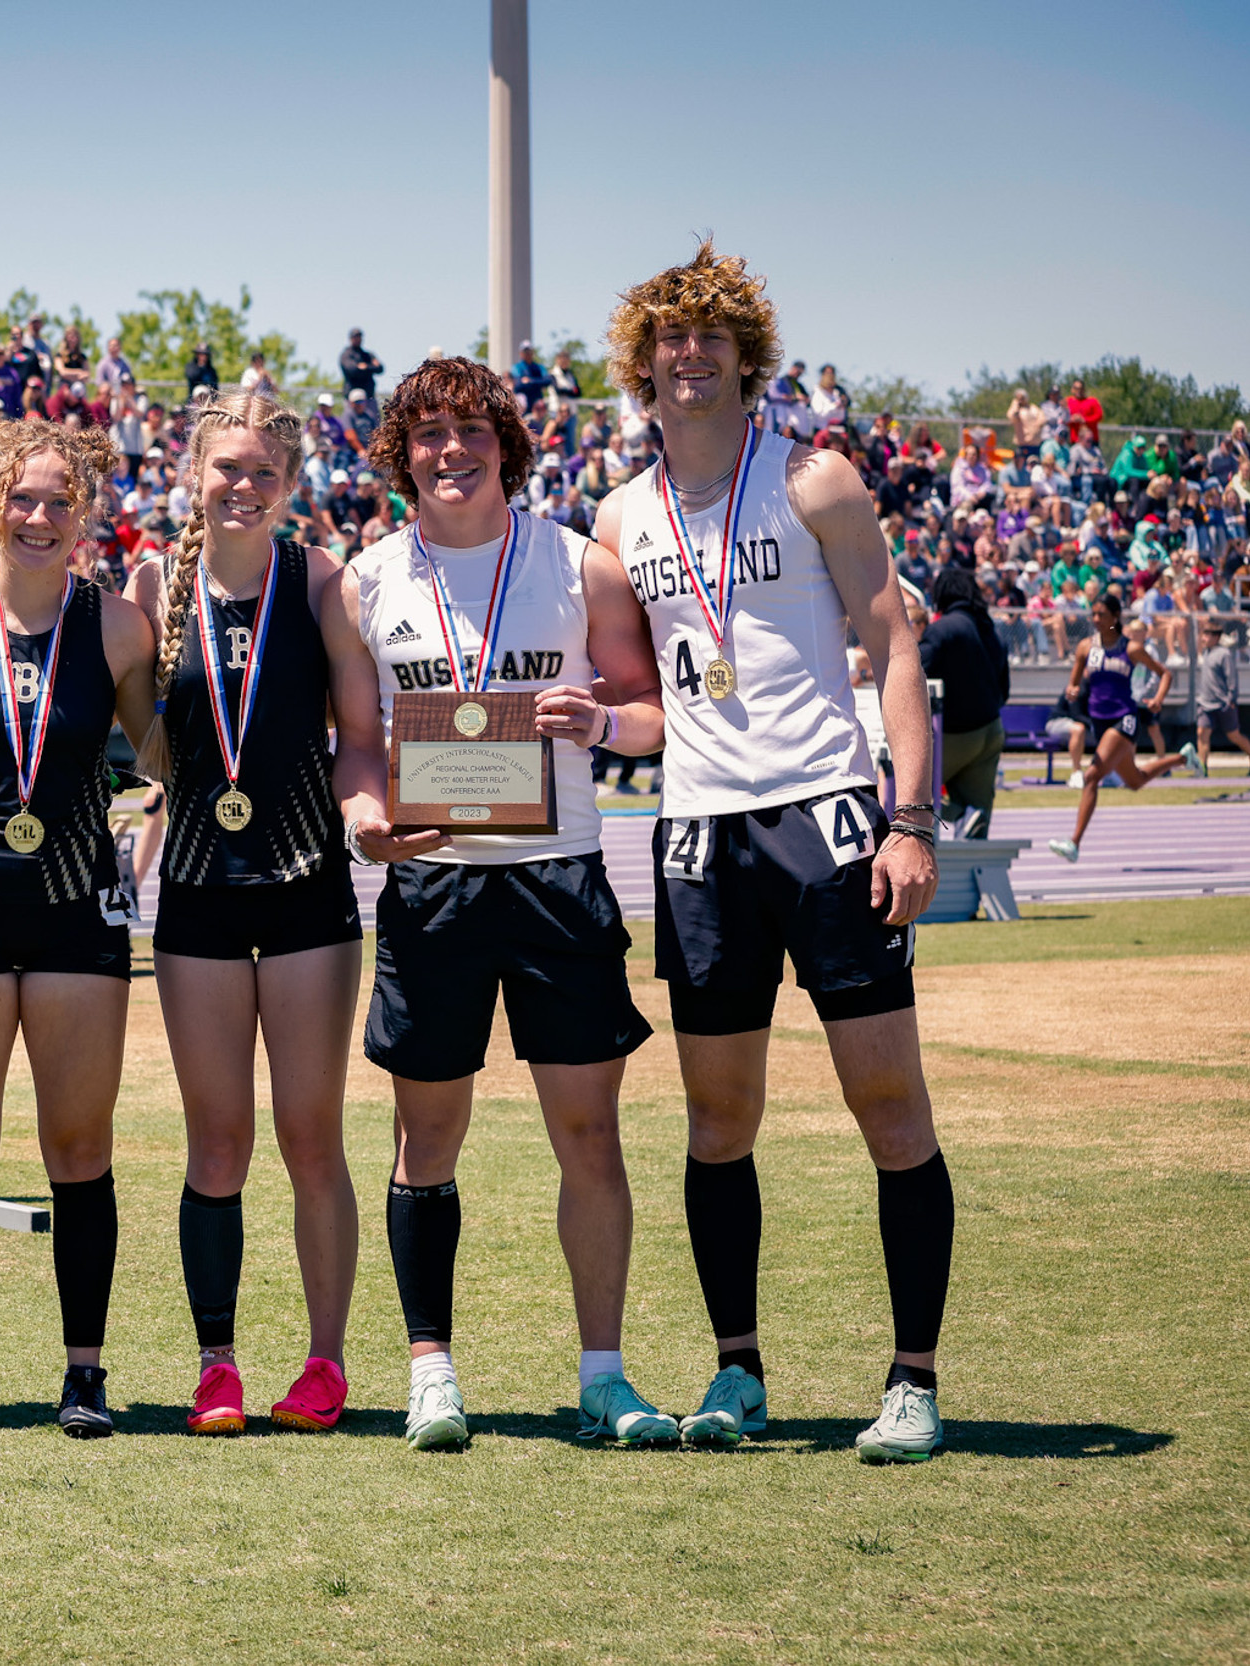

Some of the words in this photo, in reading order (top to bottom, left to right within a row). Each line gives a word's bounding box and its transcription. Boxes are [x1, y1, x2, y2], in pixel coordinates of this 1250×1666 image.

[225, 627, 254, 669] B
[385, 633, 422, 646] adidas
[11, 661, 39, 703] B
[676, 640, 702, 697] 4
[407, 754, 445, 782] UNIVERSITY
[446, 748, 509, 765] INTERSCHOLASTIC
[510, 759, 535, 782] LEAGUE
[441, 787, 486, 795] CONFERENCE
[487, 787, 501, 795] AAA
[458, 809, 481, 818] 2023
[833, 798, 868, 853] 4
[670, 819, 701, 875] 4
[105, 887, 132, 919] 4
